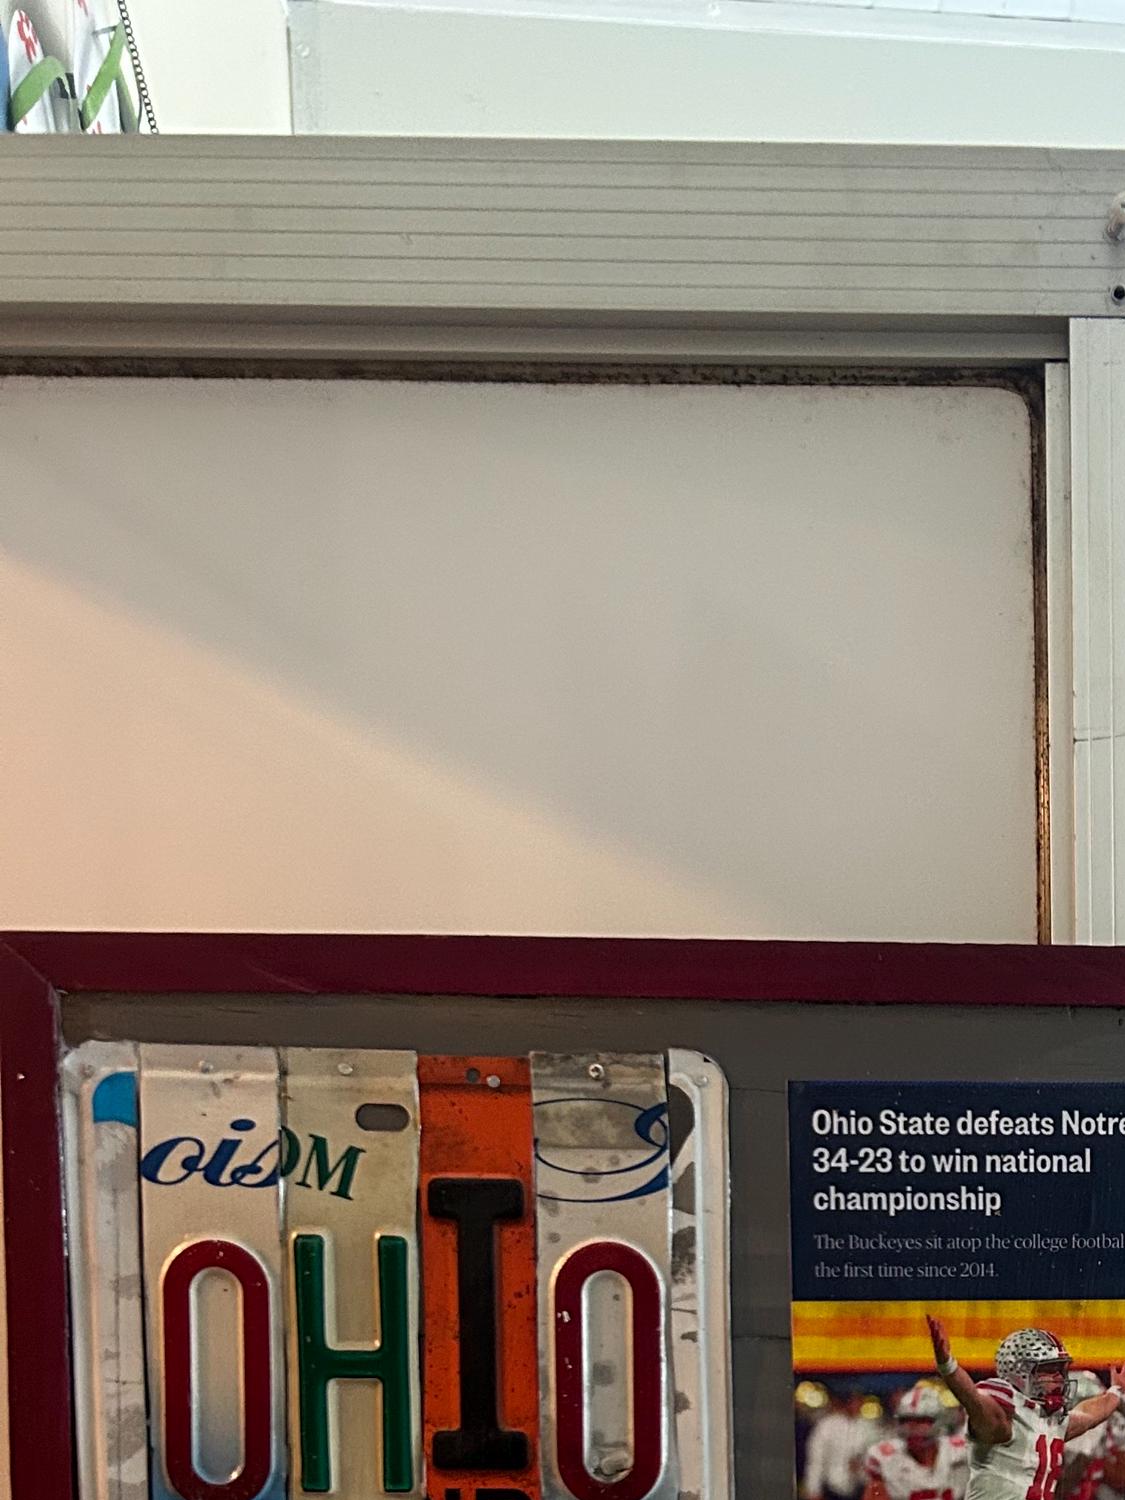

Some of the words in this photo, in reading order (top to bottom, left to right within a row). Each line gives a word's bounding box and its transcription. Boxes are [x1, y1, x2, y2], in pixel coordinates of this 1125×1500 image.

[811, 1109, 874, 1136] Ohio
[879, 1109, 950, 1136] State
[956, 1110, 1055, 1136] defeats
[812, 1148, 893, 1174] 34-23
[898, 1150, 927, 1174] to
[932, 1148, 978, 1174] win
[985, 1148, 1092, 1174] national
[812, 1186, 1002, 1217] championship
[814, 1234, 845, 1250] The
[848, 1234, 923, 1253] Buckeyes
[926, 1235, 945, 1250] sit
[946, 1237, 982, 1253] atop
[985, 1234, 1012, 1250] the
[1014, 1233, 1068, 1253] college
[814, 1263, 841, 1278] the
[844, 1262, 874, 1278] first
[877, 1263, 914, 1278] time
[917, 1263, 957, 1278] since
[959, 1263, 999, 1279] 2014.
